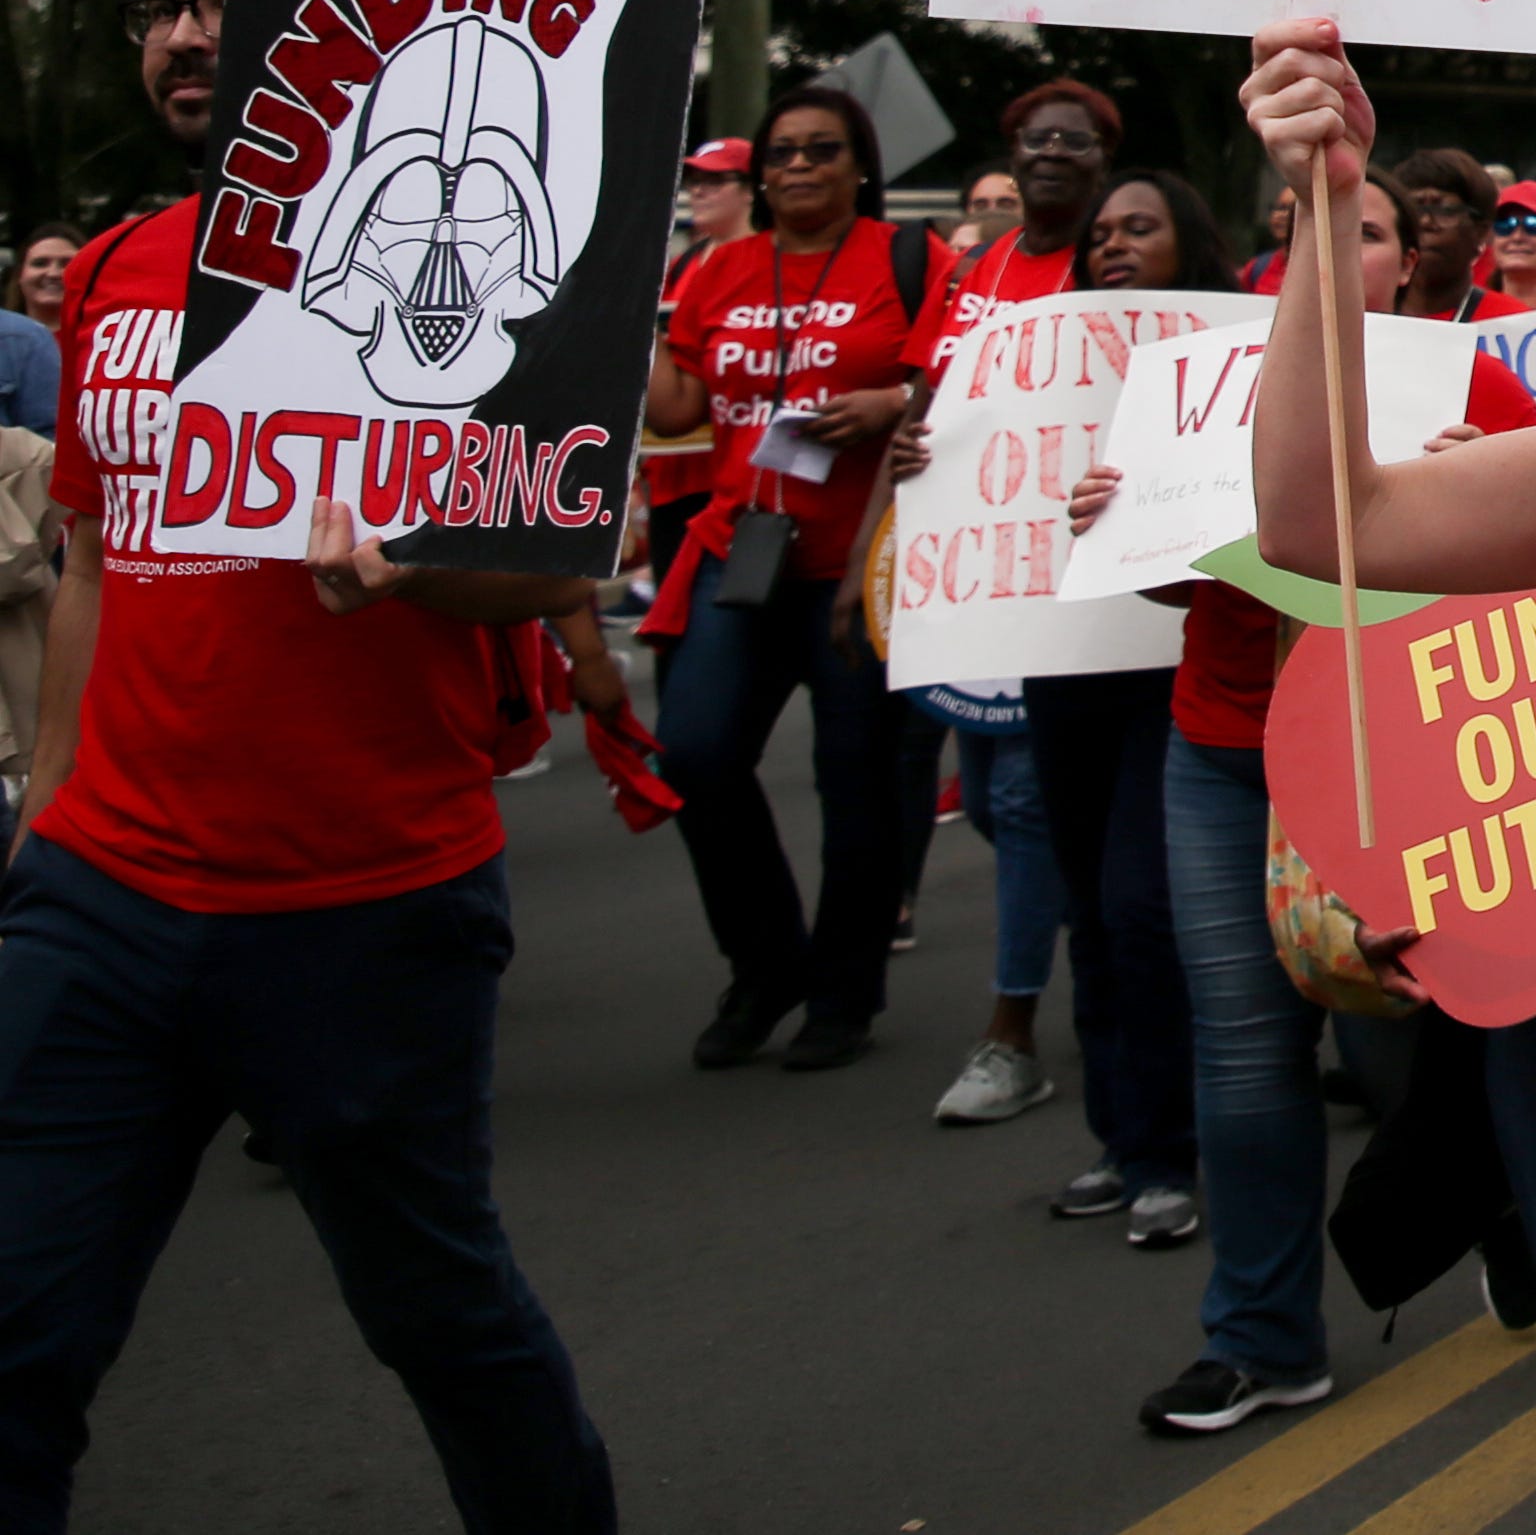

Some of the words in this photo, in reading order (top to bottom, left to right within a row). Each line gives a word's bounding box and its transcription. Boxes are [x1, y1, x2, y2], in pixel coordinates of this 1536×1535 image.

[83, 308, 186, 385] FUN
[967, 311, 1211, 399] FUN
[161, 402, 611, 528] DISTURBING.
[978, 423, 1100, 506] OU
[166, 557, 260, 576] ASSOCIATION
